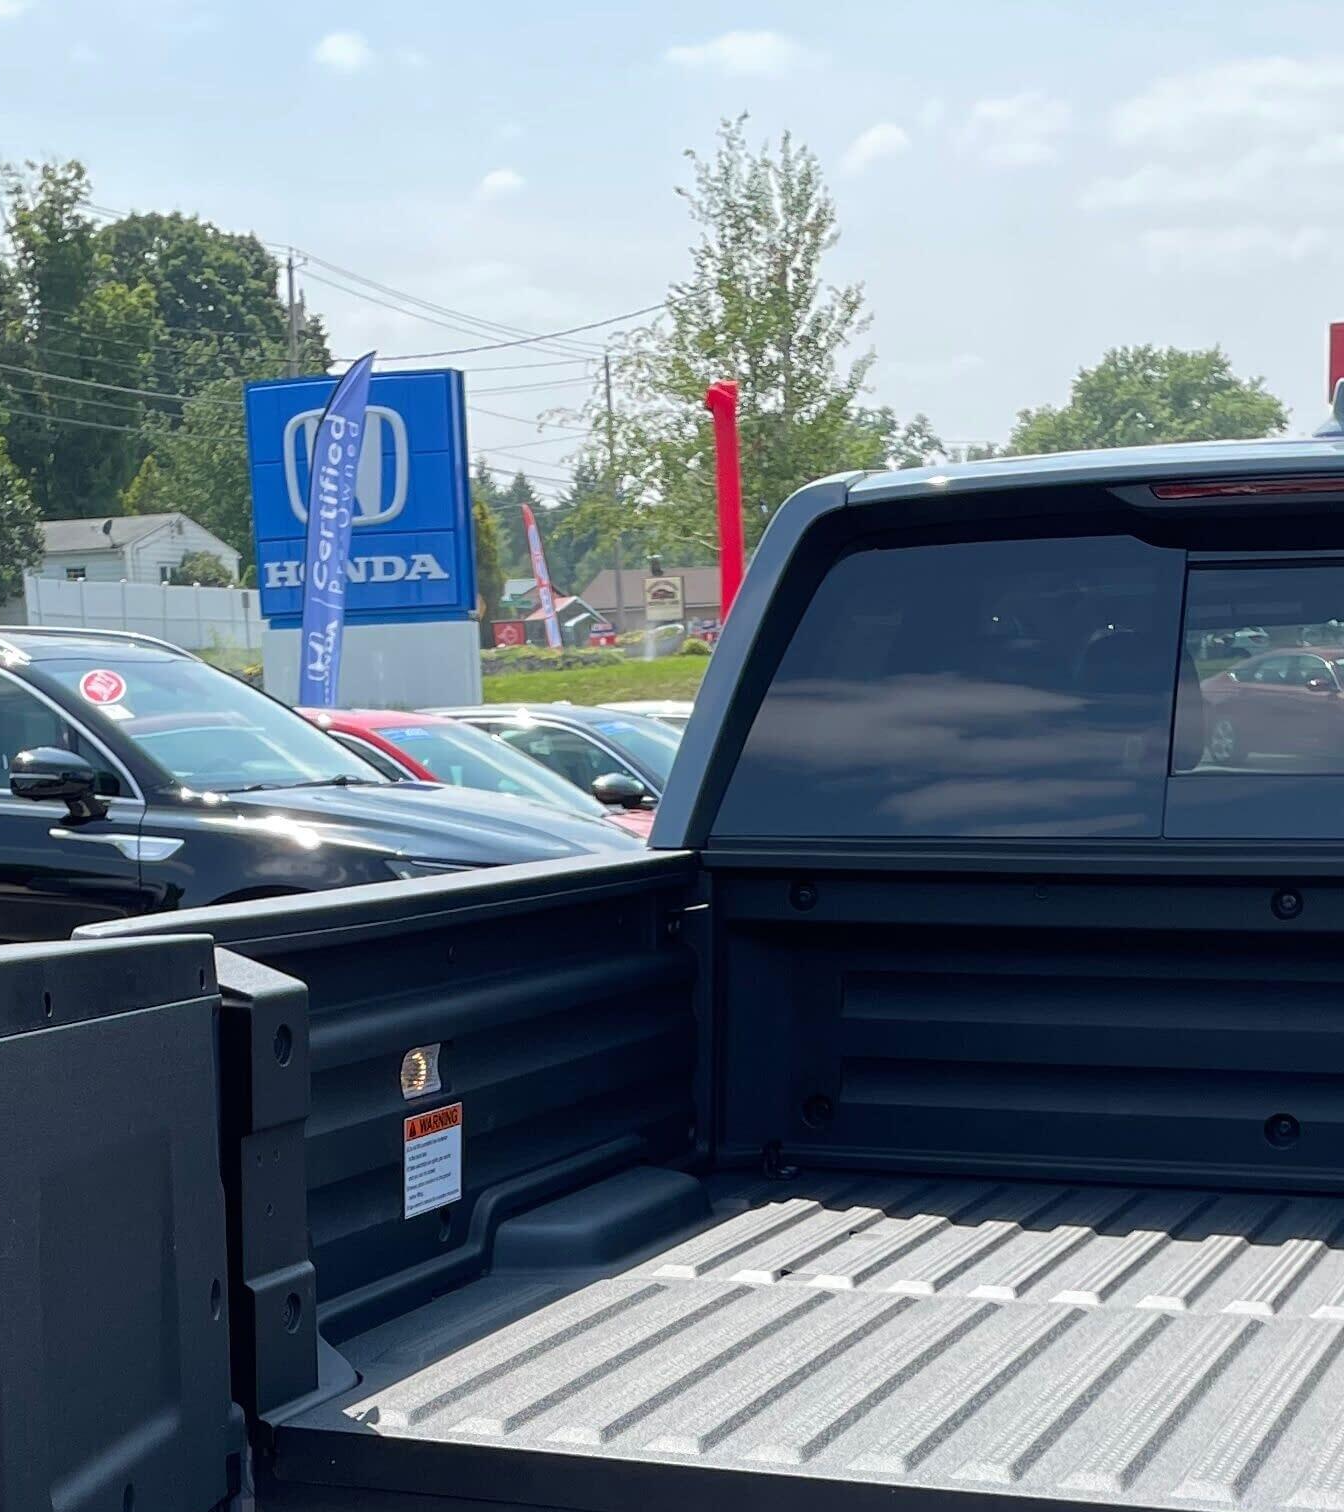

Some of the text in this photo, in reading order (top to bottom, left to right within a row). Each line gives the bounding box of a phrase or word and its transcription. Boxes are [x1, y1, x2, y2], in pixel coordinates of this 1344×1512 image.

[312, 414, 346, 591] Certified
[264, 554, 449, 589] HNDA
[420, 1109, 458, 1133] WARNING
